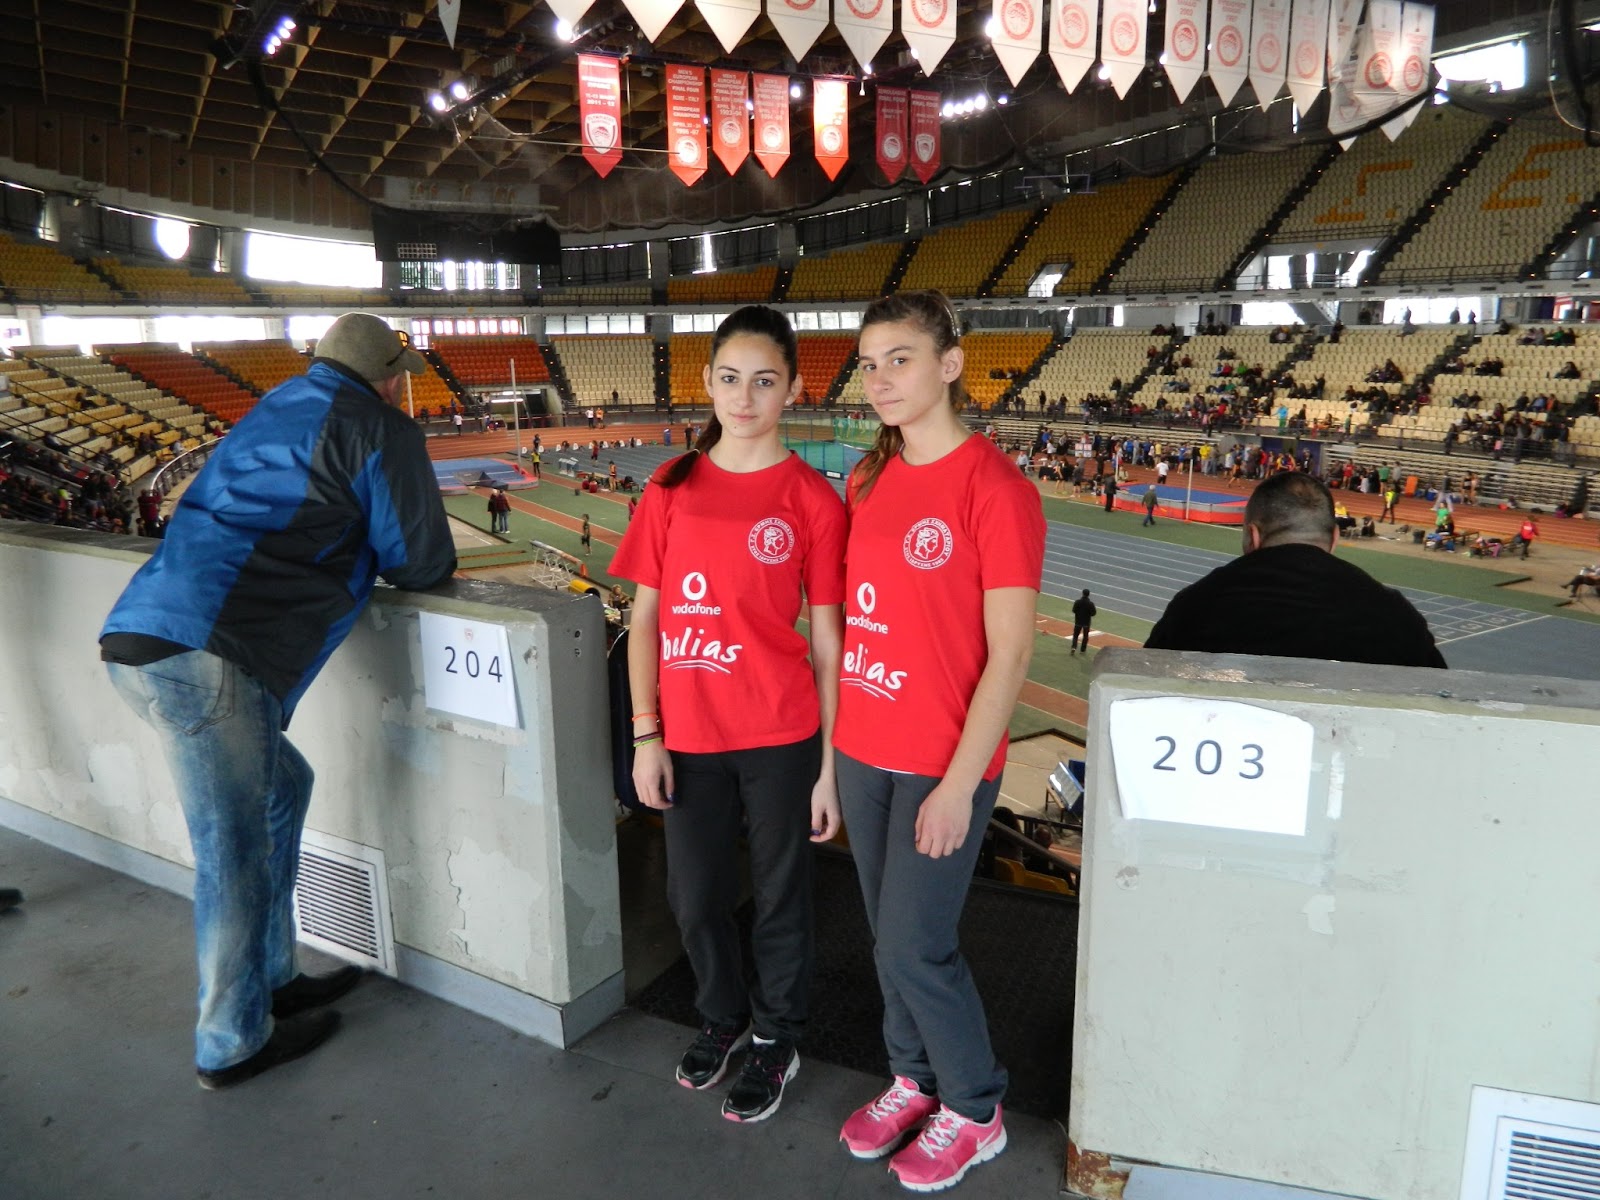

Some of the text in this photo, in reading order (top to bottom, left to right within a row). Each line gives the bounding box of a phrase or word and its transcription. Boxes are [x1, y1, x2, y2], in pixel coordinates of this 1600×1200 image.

[668, 78, 703, 86] CHAMPIONSHIP
[672, 602, 722, 615] vodafone
[662, 626, 742, 663] belias
[844, 643, 908, 690] elias
